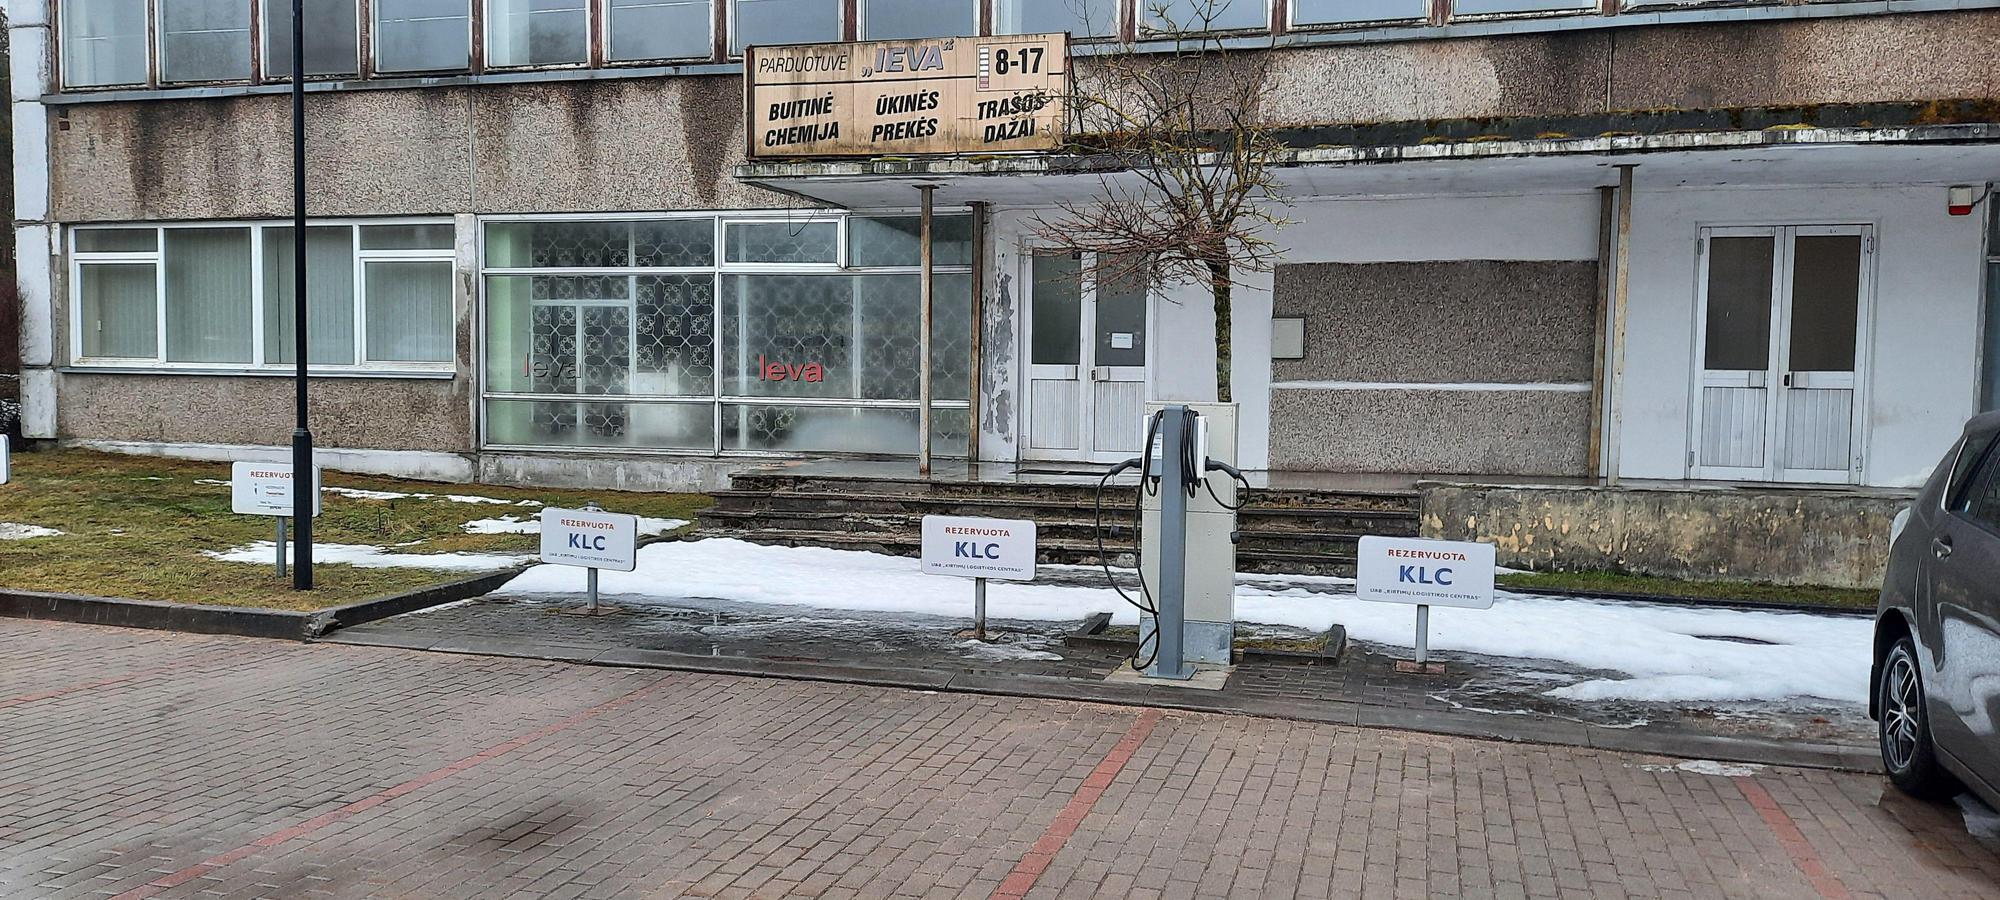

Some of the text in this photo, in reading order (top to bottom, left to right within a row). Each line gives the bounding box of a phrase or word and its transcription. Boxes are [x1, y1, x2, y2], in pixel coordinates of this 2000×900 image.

[759, 51, 848, 73] PARDUOTUVĖ
[995, 47, 1044, 75] 8-17
[768, 91, 834, 122] BUITINĖ
[876, 89, 940, 116] ŪKINĖS
[977, 91, 1046, 121] TRAŠOS
[765, 121, 840, 147] CHEMIJA
[871, 116, 938, 143] PREKĖS
[983, 115, 1036, 144] DAŽAI
[759, 352, 824, 383] Ieva
[560, 518, 615, 530] REZERVUOTA
[945, 526, 1011, 537] REZERVUOTA
[568, 532, 606, 551] KLC
[955, 541, 1001, 560] KLC
[1388, 548, 1467, 561] REZERVUOTA
[1399, 564, 1453, 586] KLC
